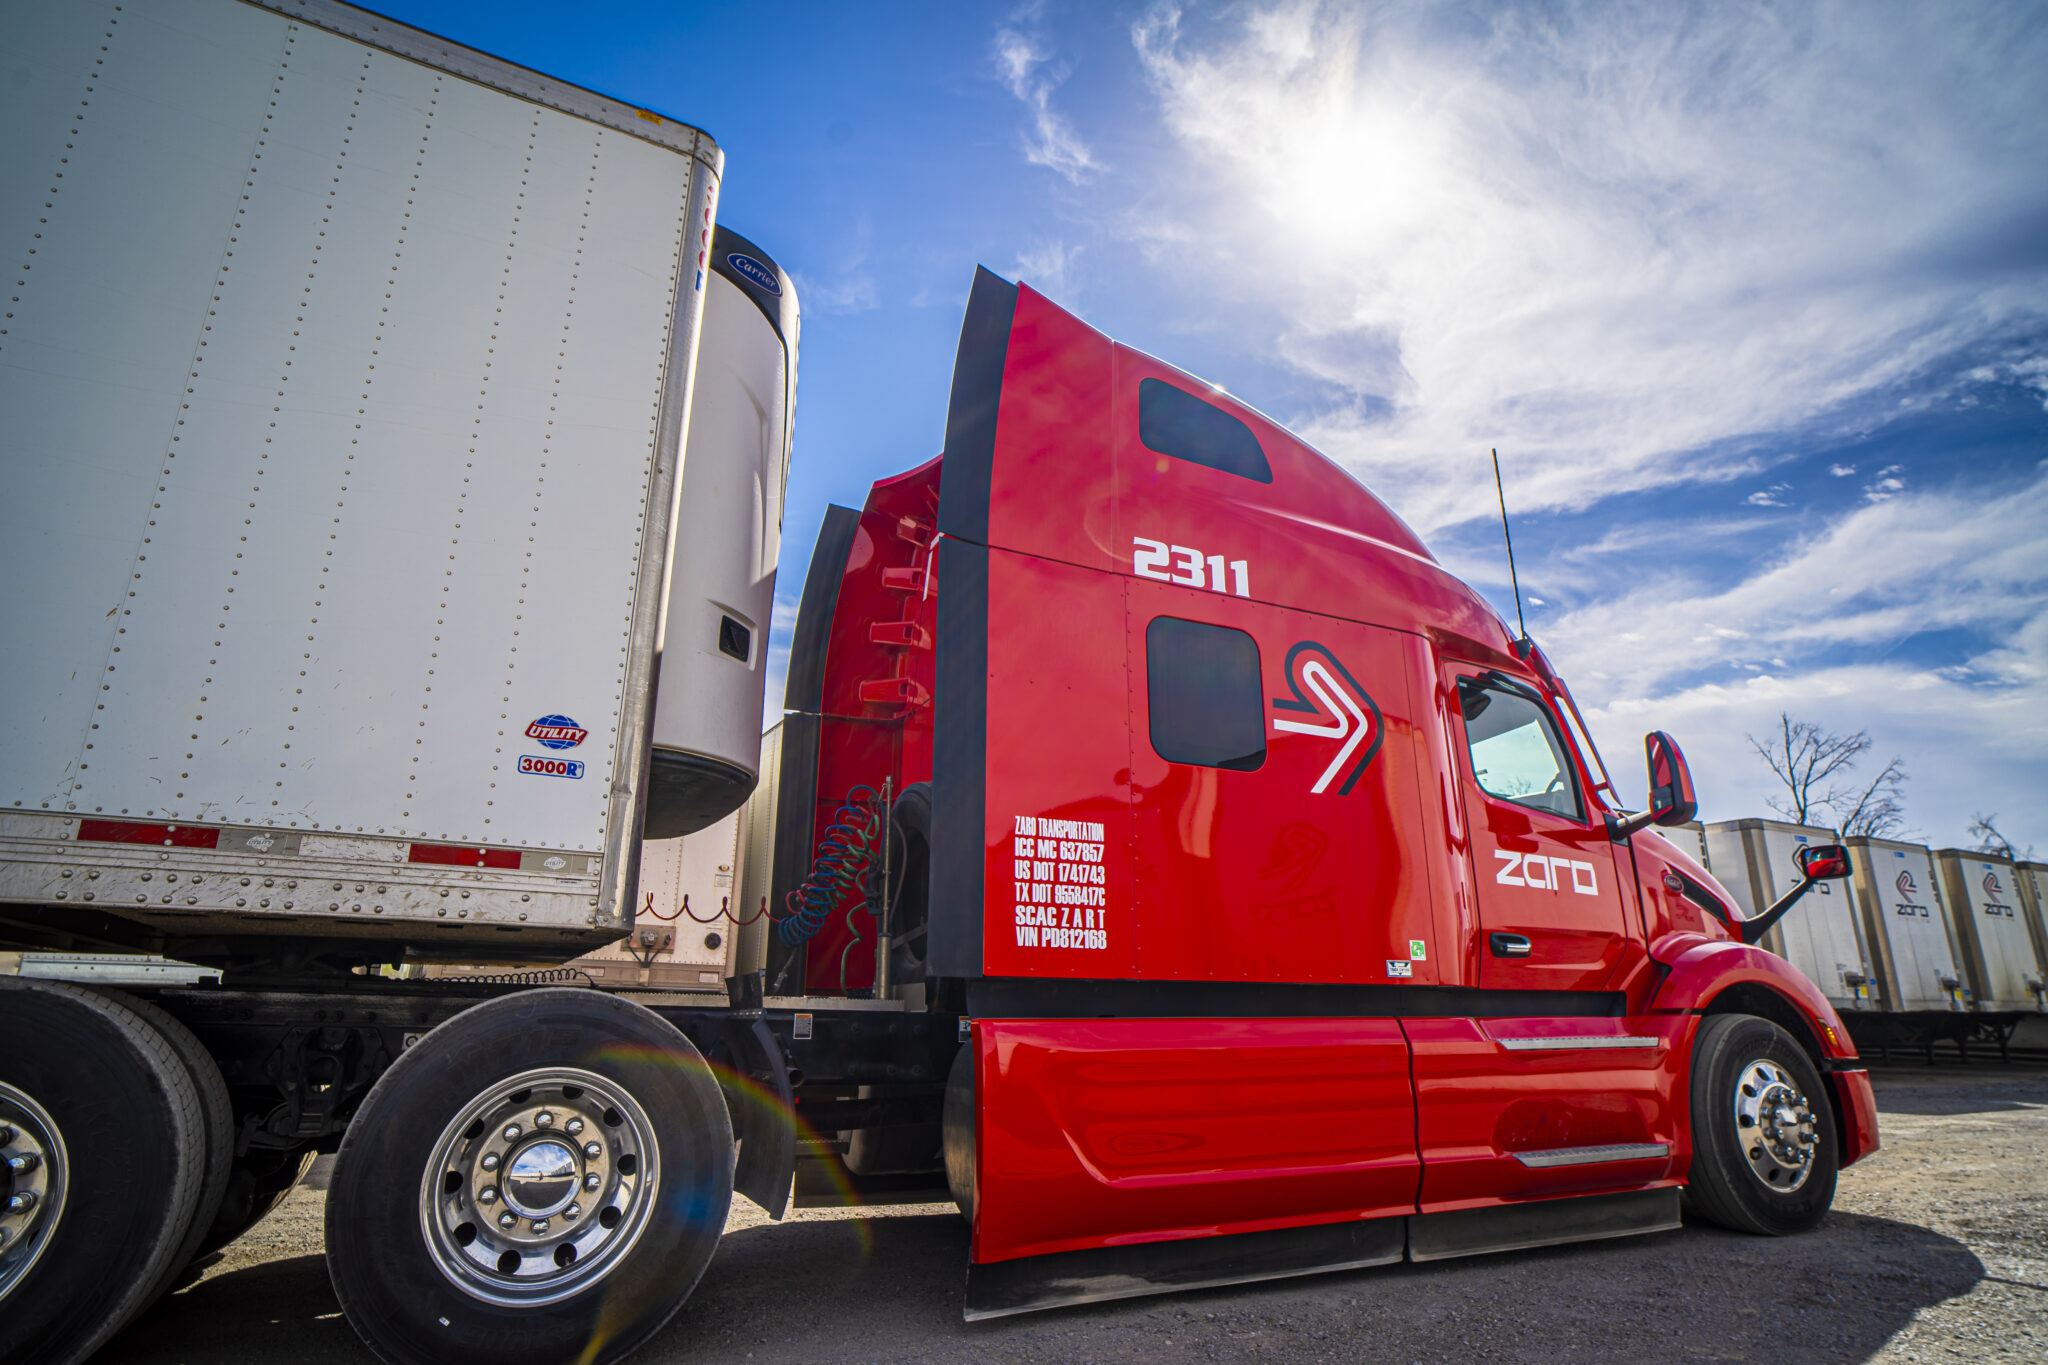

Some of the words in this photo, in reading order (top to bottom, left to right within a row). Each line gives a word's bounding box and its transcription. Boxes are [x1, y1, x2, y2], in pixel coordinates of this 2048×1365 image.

[736, 258, 776, 287] Carrier
[1133, 536, 1250, 598] 2311
[528, 725, 585, 740] UTILITY
[1015, 815, 1036, 836] ZARO
[1037, 818, 1104, 842] TRANSPORTATION
[1015, 837, 1034, 857] ICC
[1037, 839, 1057, 859] MC
[1060, 841, 1104, 862] 637857
[1015, 860, 1030, 880] US
[1033, 861, 1055, 881] DOT
[1058, 863, 1105, 884] 1741743
[1494, 849, 1599, 896] zaro
[1015, 882, 1030, 902] TX
[1032, 883, 1052, 903] DOT
[1055, 885, 1106, 906] 9558417C
[1015, 905, 1057, 926] SCAC
[1061, 907, 1070, 927] Z
[1073, 908, 1083, 928] A
[1085, 909, 1095, 928] R
[1097, 909, 1105, 929] T
[1896, 903, 1929, 918] zaro
[1983, 903, 2014, 918] zaro
[1016, 926, 1038, 947] VIN
[1041, 928, 1107, 949] PD812168
